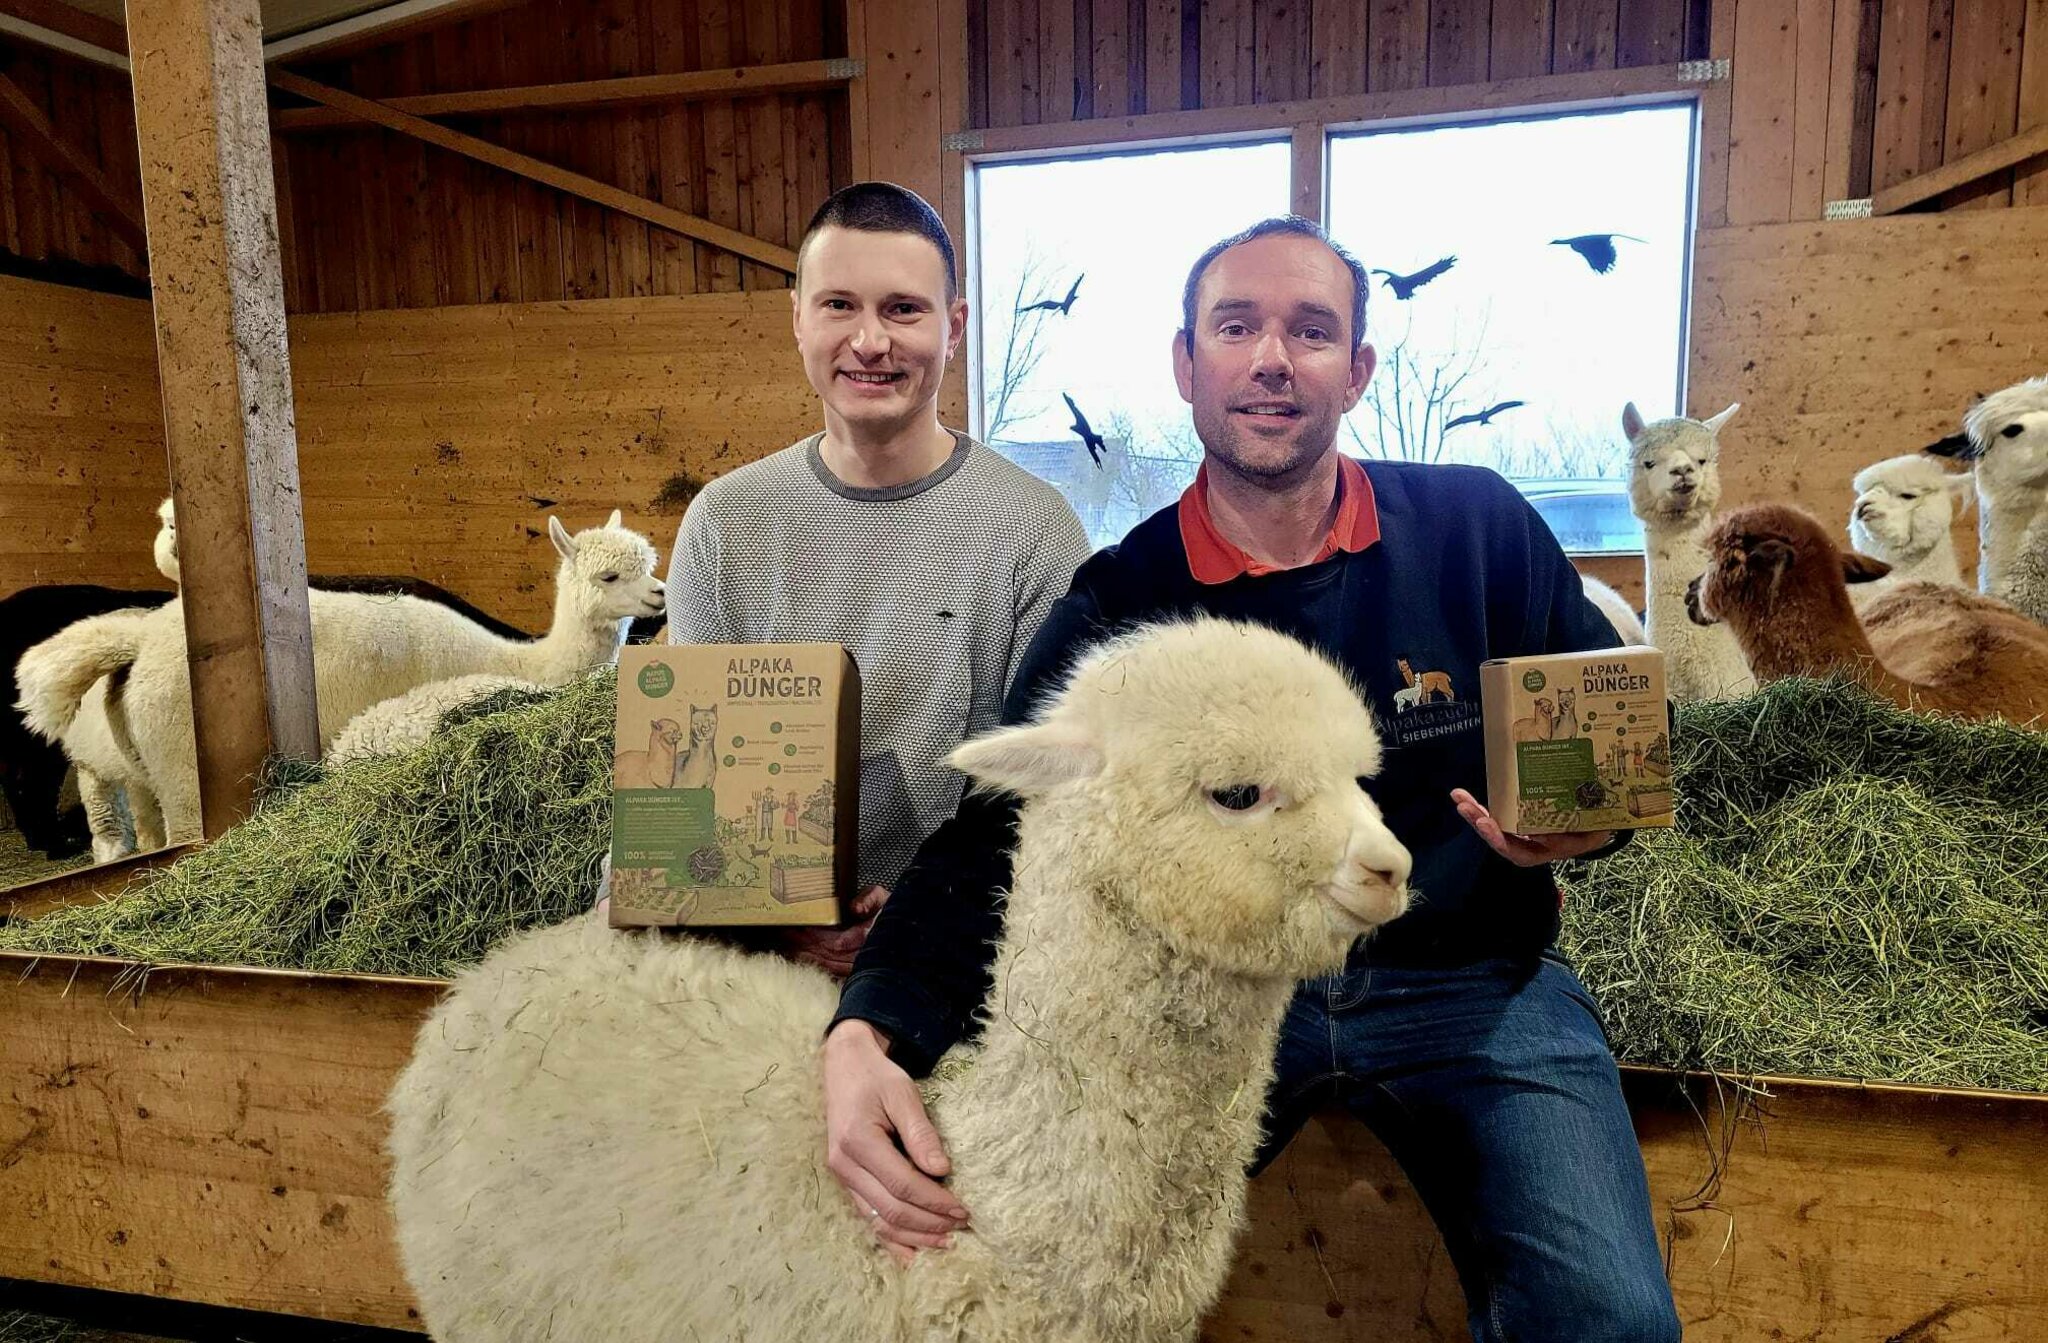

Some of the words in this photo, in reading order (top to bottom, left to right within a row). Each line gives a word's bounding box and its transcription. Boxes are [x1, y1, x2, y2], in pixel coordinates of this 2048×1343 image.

[726, 658, 794, 674] ALPAKA
[1582, 664, 1629, 677] ALPAKA
[727, 674, 822, 698] DÜNGER
[1583, 674, 1650, 694] DÜNGER
[1402, 716, 1482, 743] SIEBENHIRTEN
[1525, 786, 1544, 795] 100%
[624, 850, 646, 861] 100%
